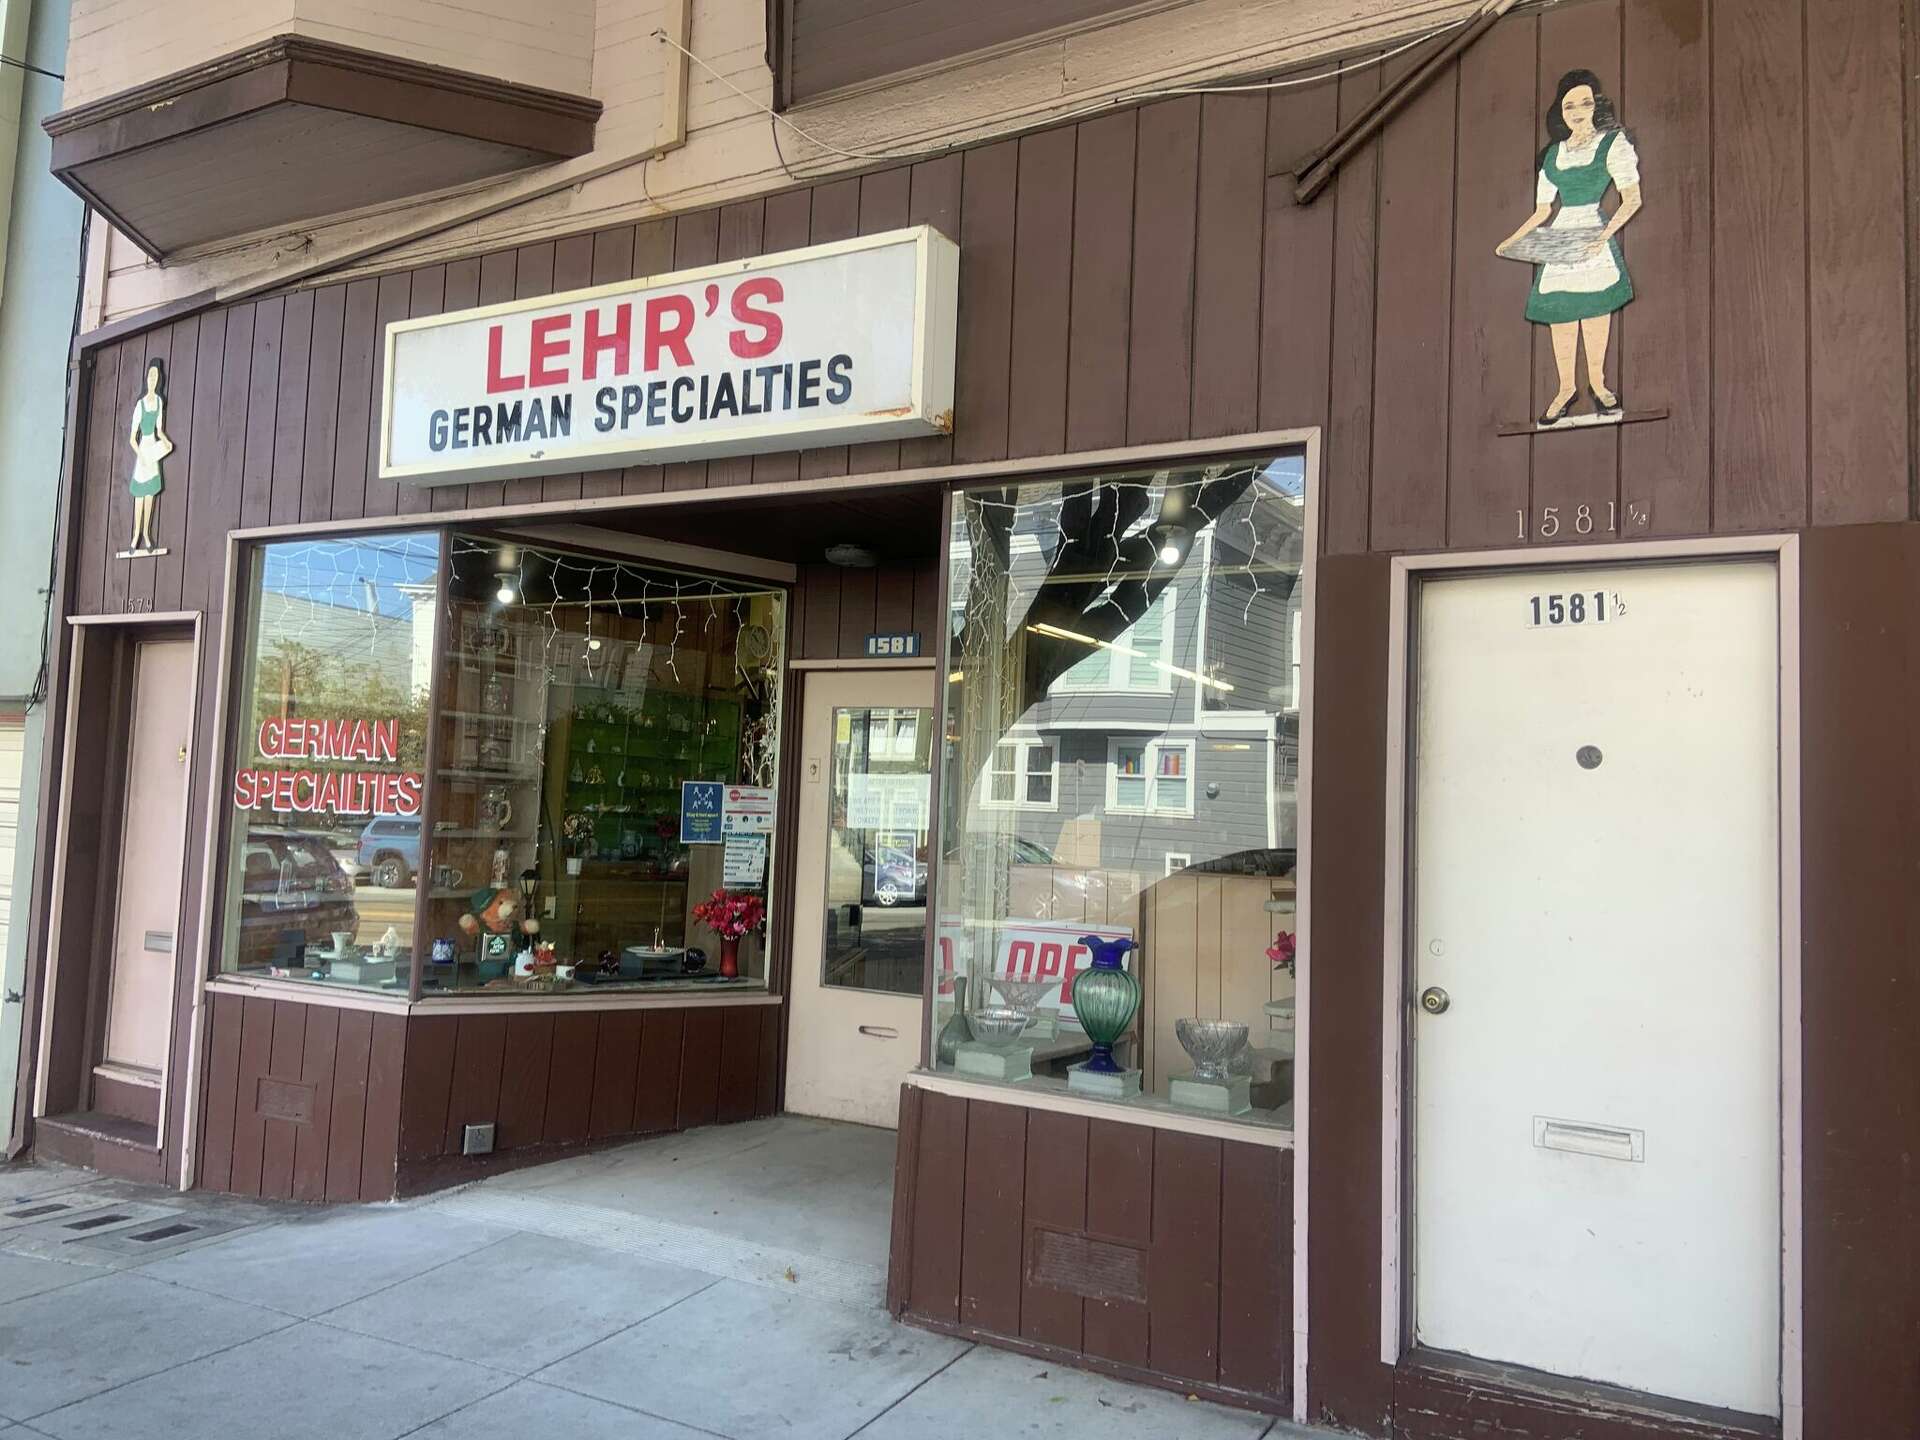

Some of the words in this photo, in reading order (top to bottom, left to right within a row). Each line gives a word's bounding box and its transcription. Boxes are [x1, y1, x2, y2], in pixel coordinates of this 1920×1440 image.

[486, 276, 785, 394] LEHR'S
[429, 393, 572, 452] GERMAN
[594, 354, 854, 433] SPECIALTIES
[1516, 502, 1616, 538] 1581
[1531, 592, 1605, 625] 1581
[869, 636, 914, 654] 1581
[258, 716, 399, 761] GERMAN
[233, 767, 423, 816] SPECIALTIES
[1005, 940, 1088, 1004] OPE
